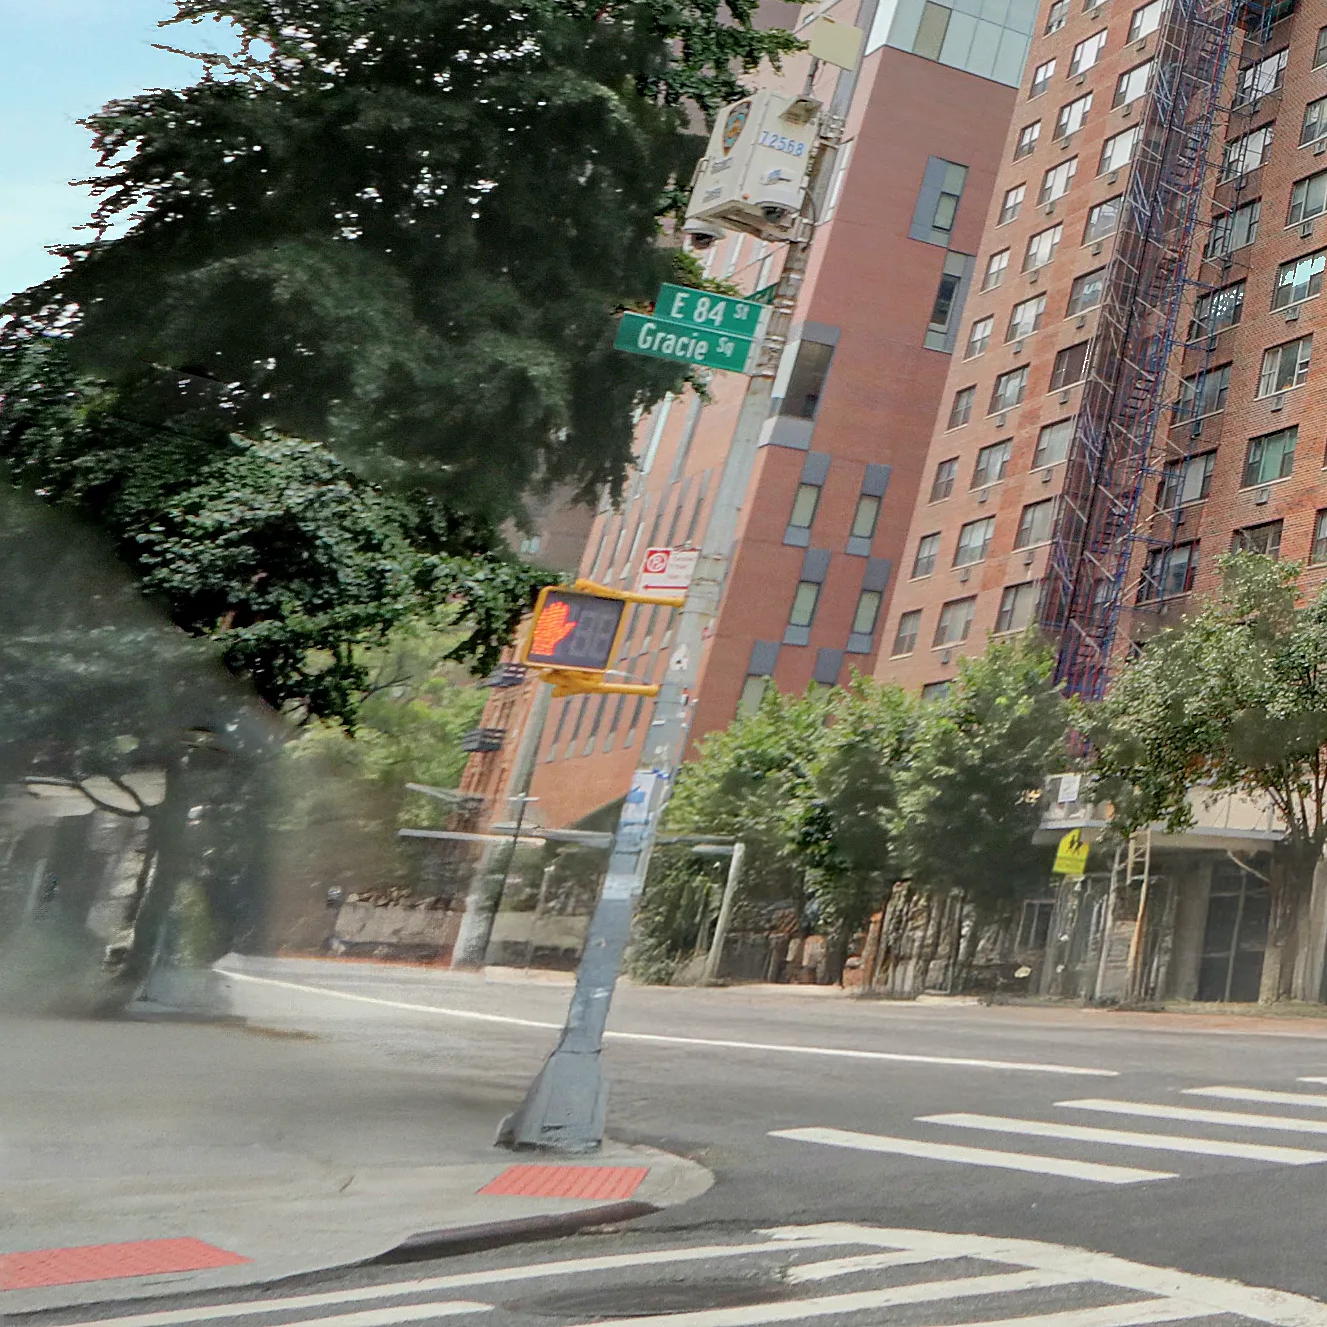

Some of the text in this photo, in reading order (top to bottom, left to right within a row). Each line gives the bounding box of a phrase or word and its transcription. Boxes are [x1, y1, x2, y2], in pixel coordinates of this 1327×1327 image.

[760, 131, 805, 157] 72568
[671, 292, 690, 318] E
[693, 297, 726, 326] 84
[638, 323, 735, 361] Gracie Sq
